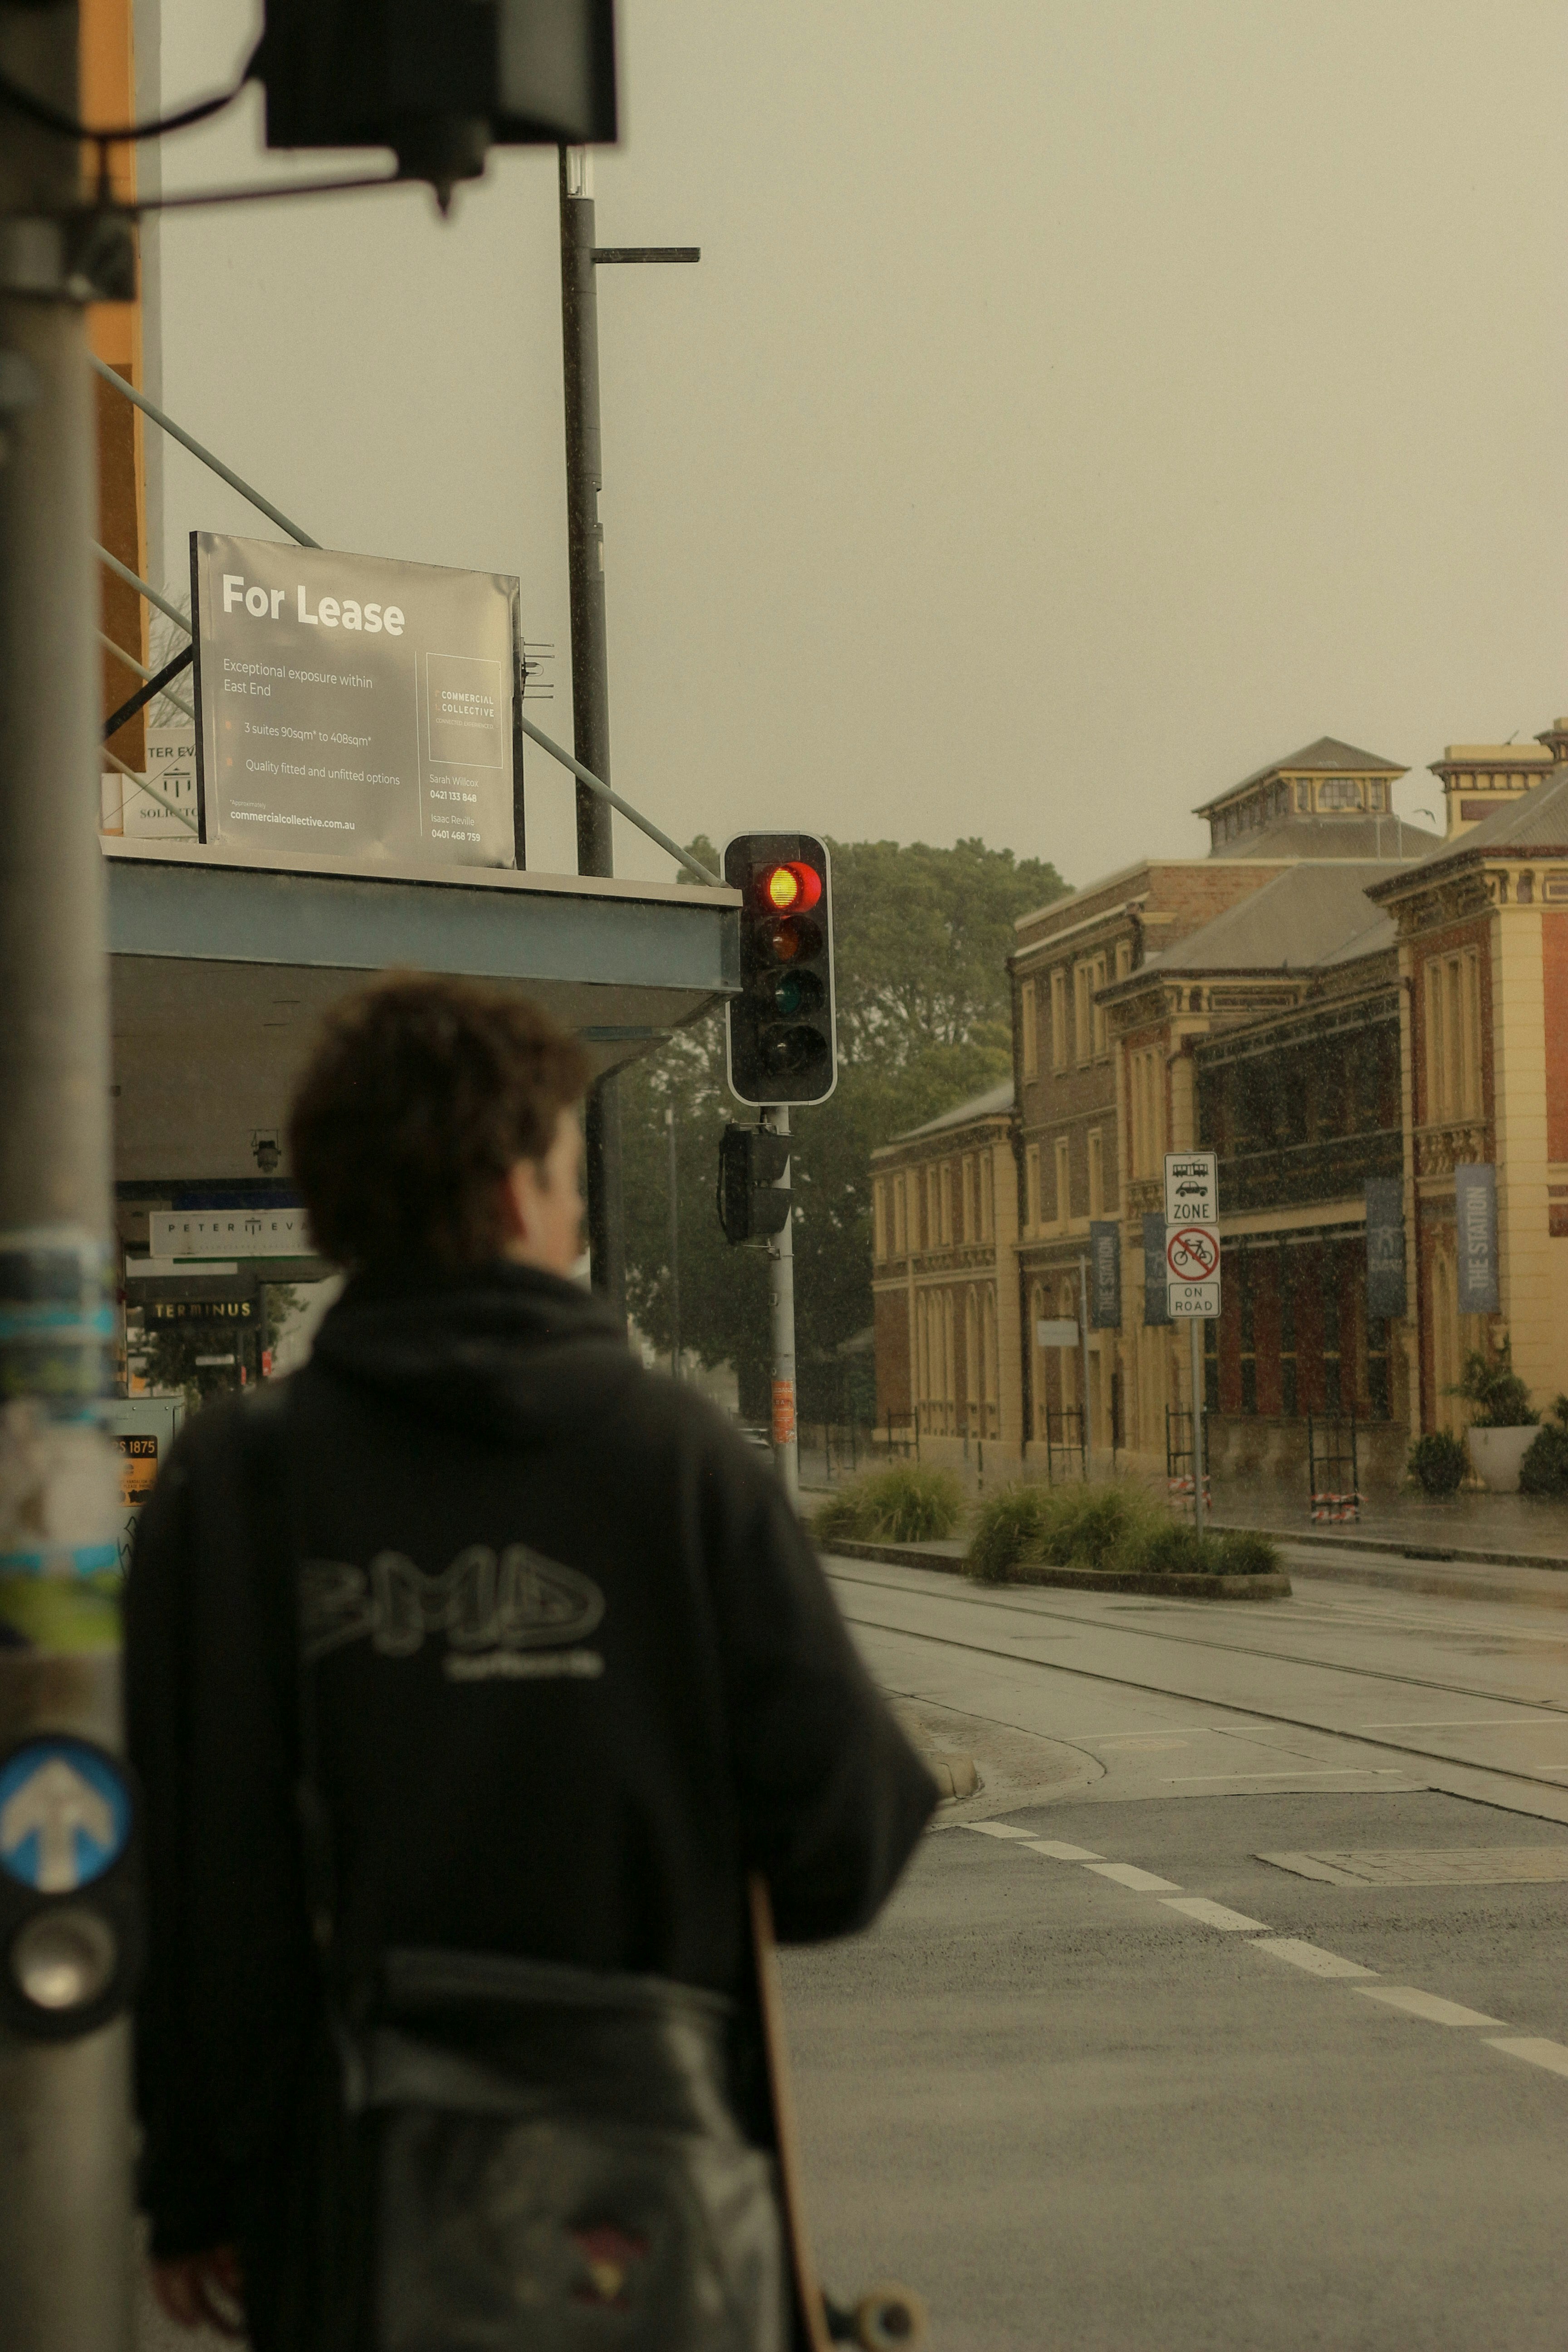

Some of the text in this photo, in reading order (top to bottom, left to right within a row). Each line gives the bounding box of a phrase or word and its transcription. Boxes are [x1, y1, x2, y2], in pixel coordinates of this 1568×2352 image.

[223, 574, 405, 636] For Lease
[224, 658, 373, 688] Exceptional exposure within
[224, 679, 271, 696] East End
[441, 691, 494, 705] COMMERCIAL
[442, 704, 495, 717] COLLECTIVE
[244, 722, 250, 733] 3
[252, 724, 279, 736] suites
[318, 732, 328, 742] to
[148, 746, 196, 758] TER EV
[246, 759, 400, 785] Quality fitted and unfitted options
[430, 774, 479, 787] Sarah Willcox
[430, 790, 477, 802] 0421 133 848
[230, 810, 355, 830] commercialcollective.com.au
[431, 814, 475, 826] Isaac Reville
[431, 829, 481, 842] 0401 468 759
[1174, 1203, 1210, 1219] ZONE
[168, 1223, 235, 1232] PETER
[1466, 1186, 1490, 1290] THE STATION
[1185, 1288, 1202, 1298] ON
[155, 1302, 251, 1318] TERMINUS
[1176, 1300, 1213, 1311] ROAD
[130, 1441, 155, 1454] 1875
